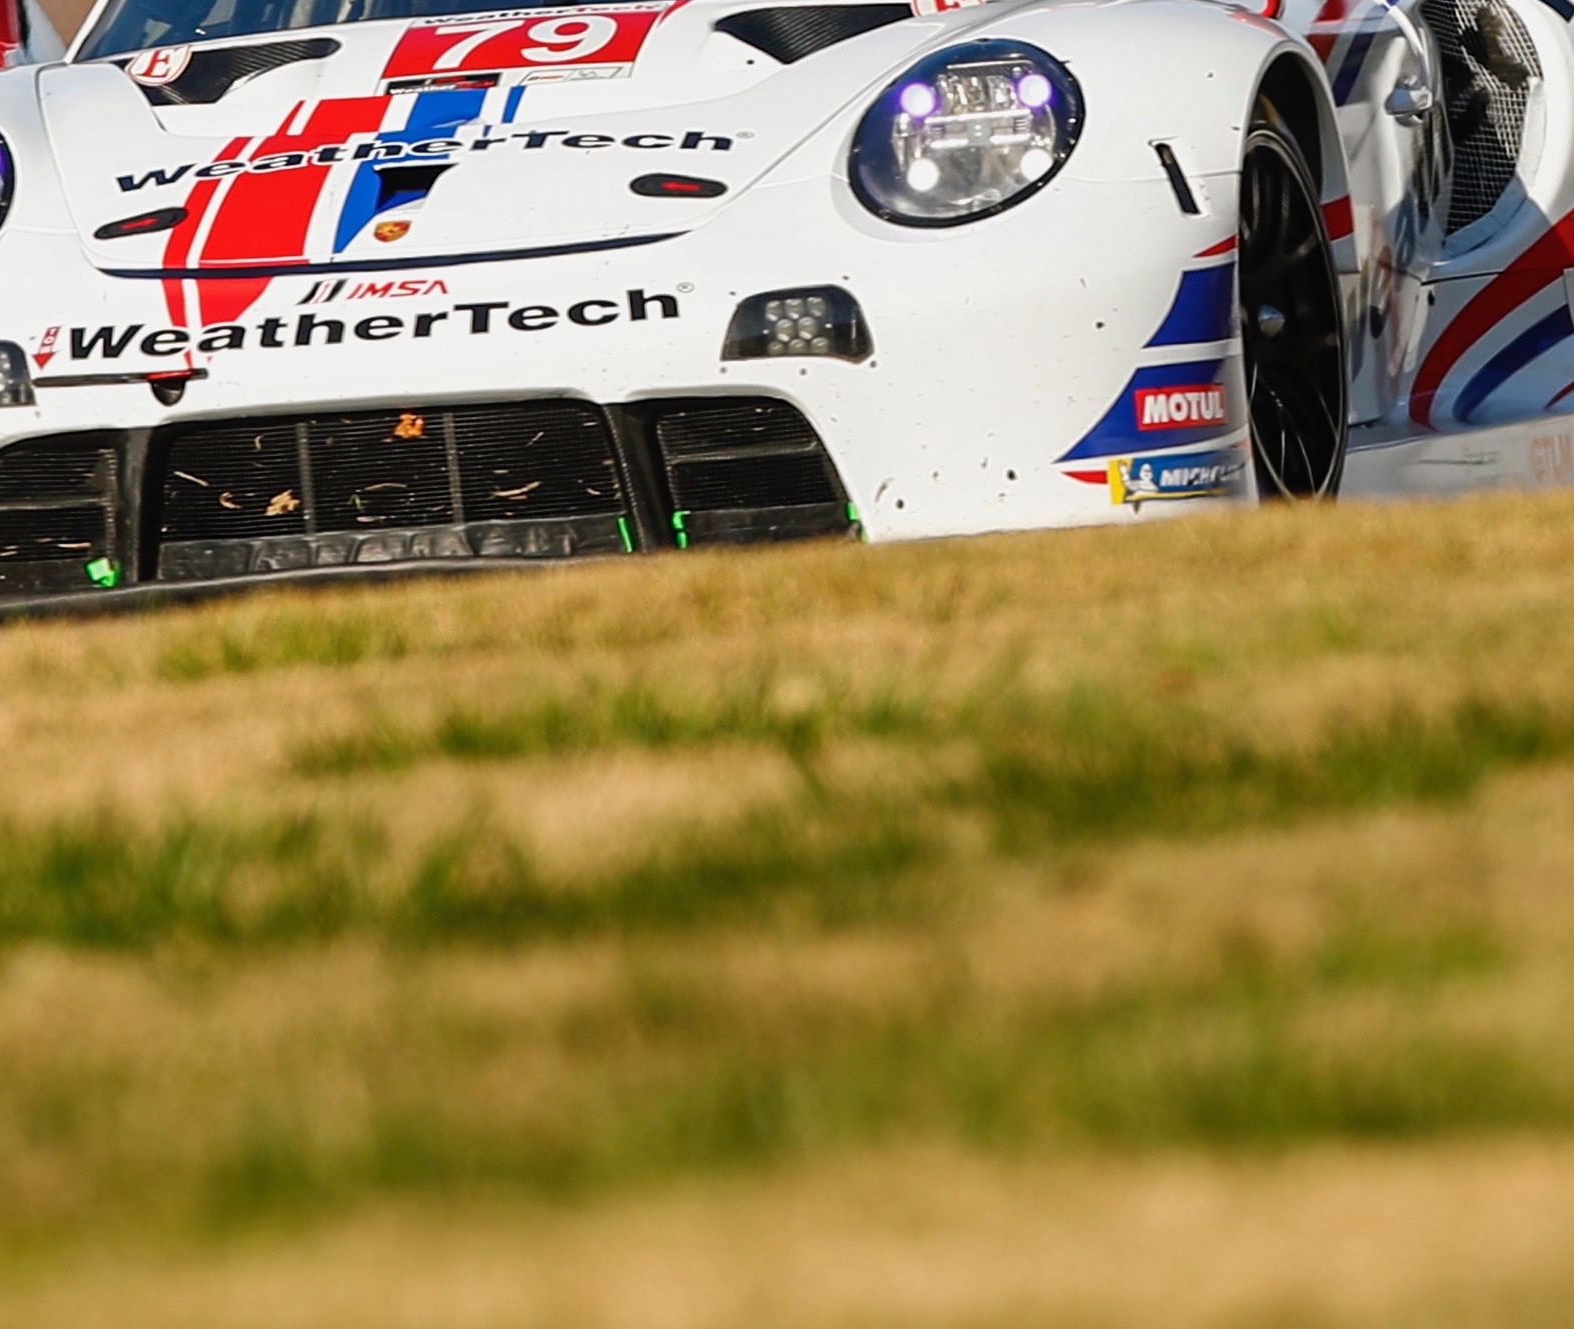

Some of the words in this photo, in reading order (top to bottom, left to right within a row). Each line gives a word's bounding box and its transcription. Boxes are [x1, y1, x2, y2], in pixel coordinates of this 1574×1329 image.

[424, 3, 662, 25] WeatherTech
[431, 14, 618, 71] 79
[137, 50, 172, 78] E
[116, 129, 735, 193] WeatherTech
[345, 279, 449, 300] IMSA
[69, 286, 681, 360] WeatherTech
[1142, 385, 1225, 425] MOTUL
